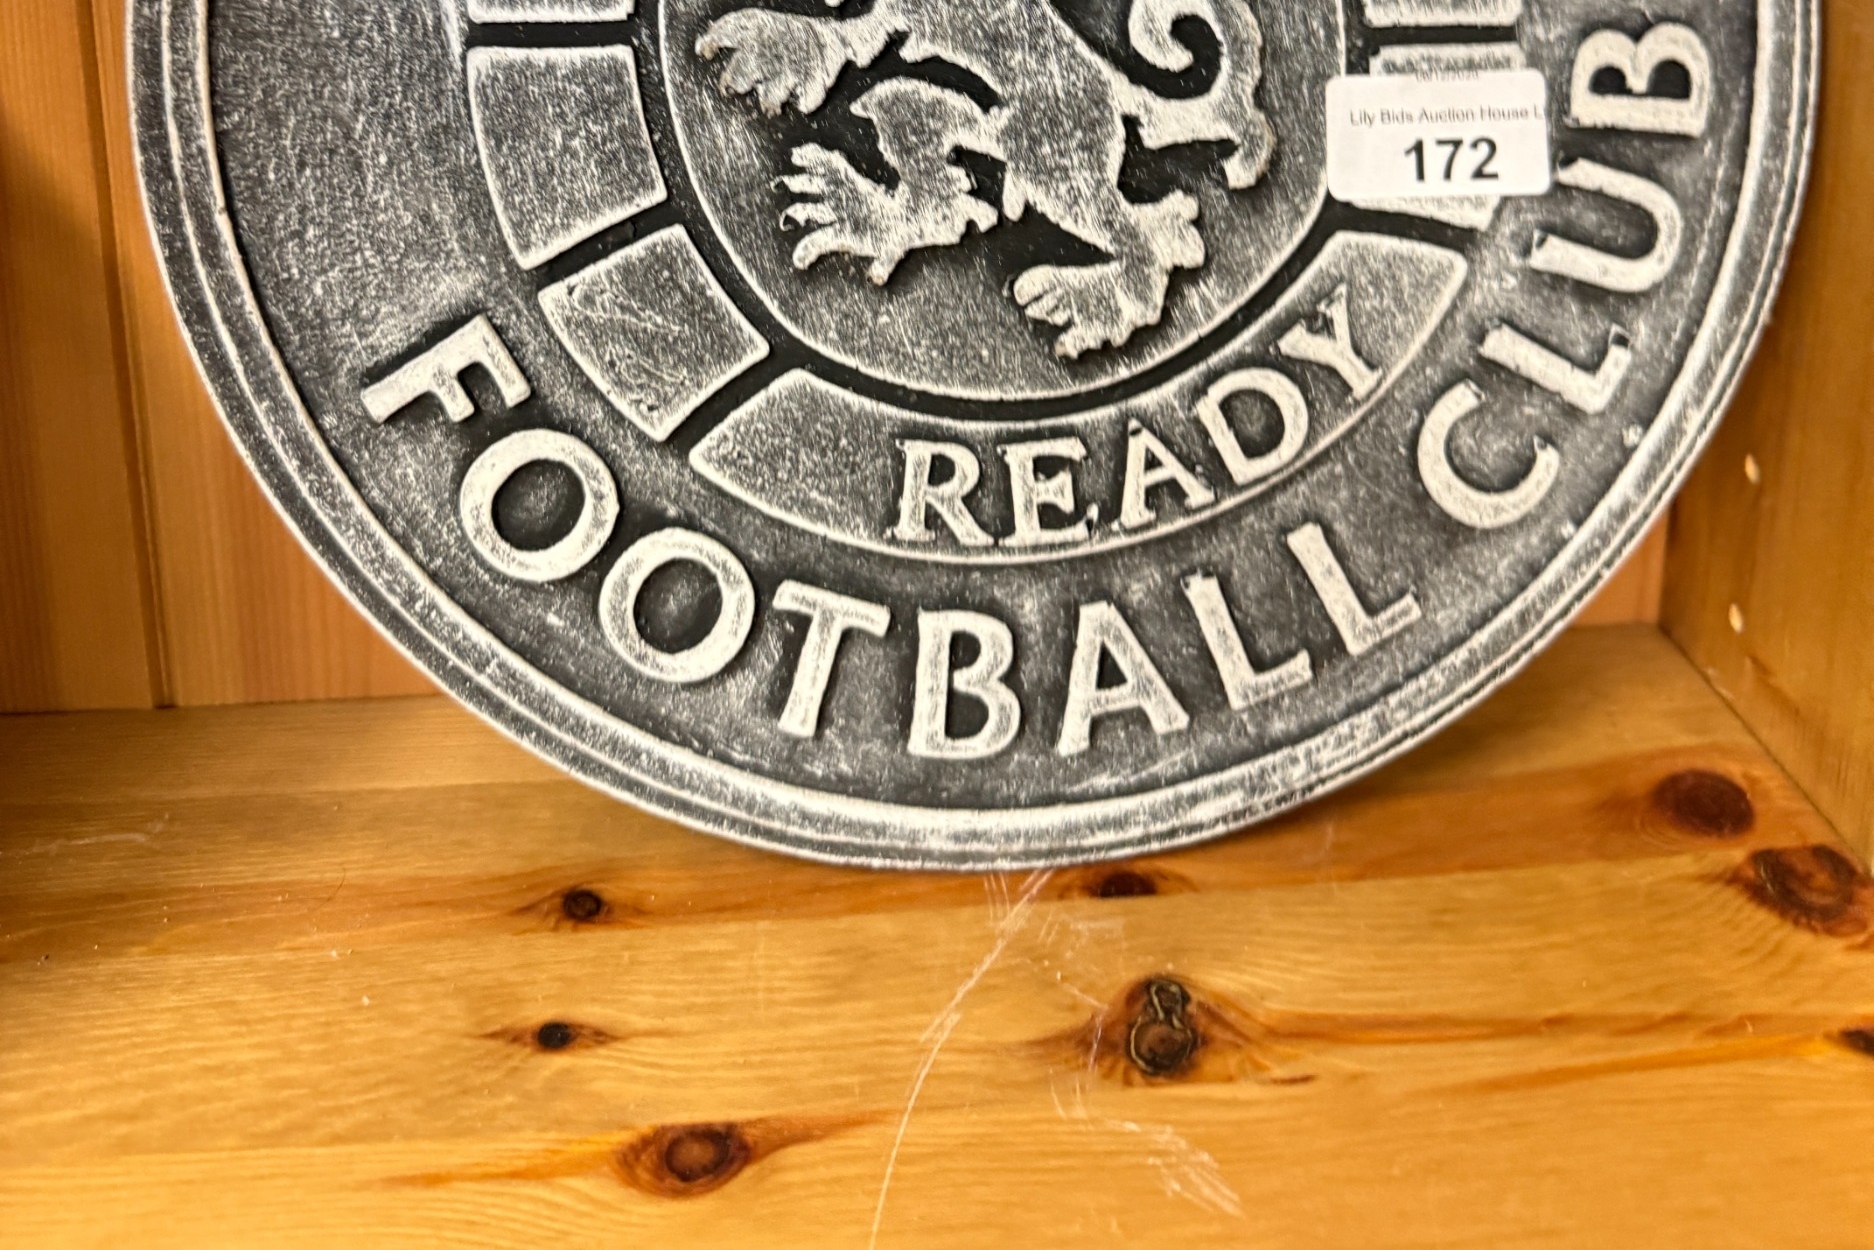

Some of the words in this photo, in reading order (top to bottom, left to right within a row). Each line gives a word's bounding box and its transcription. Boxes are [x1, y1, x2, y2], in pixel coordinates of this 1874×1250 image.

[1350, 108, 1376, 128] Lily
[1380, 107, 1414, 126] Bids
[1418, 105, 1475, 125] Auction
[1480, 104, 1529, 121] House
[1403, 134, 1500, 183] 172
[361, 314, 1422, 761] FOOTBALL
[1416, 18, 1713, 531] CLUB
[892, 280, 1388, 549] READY
